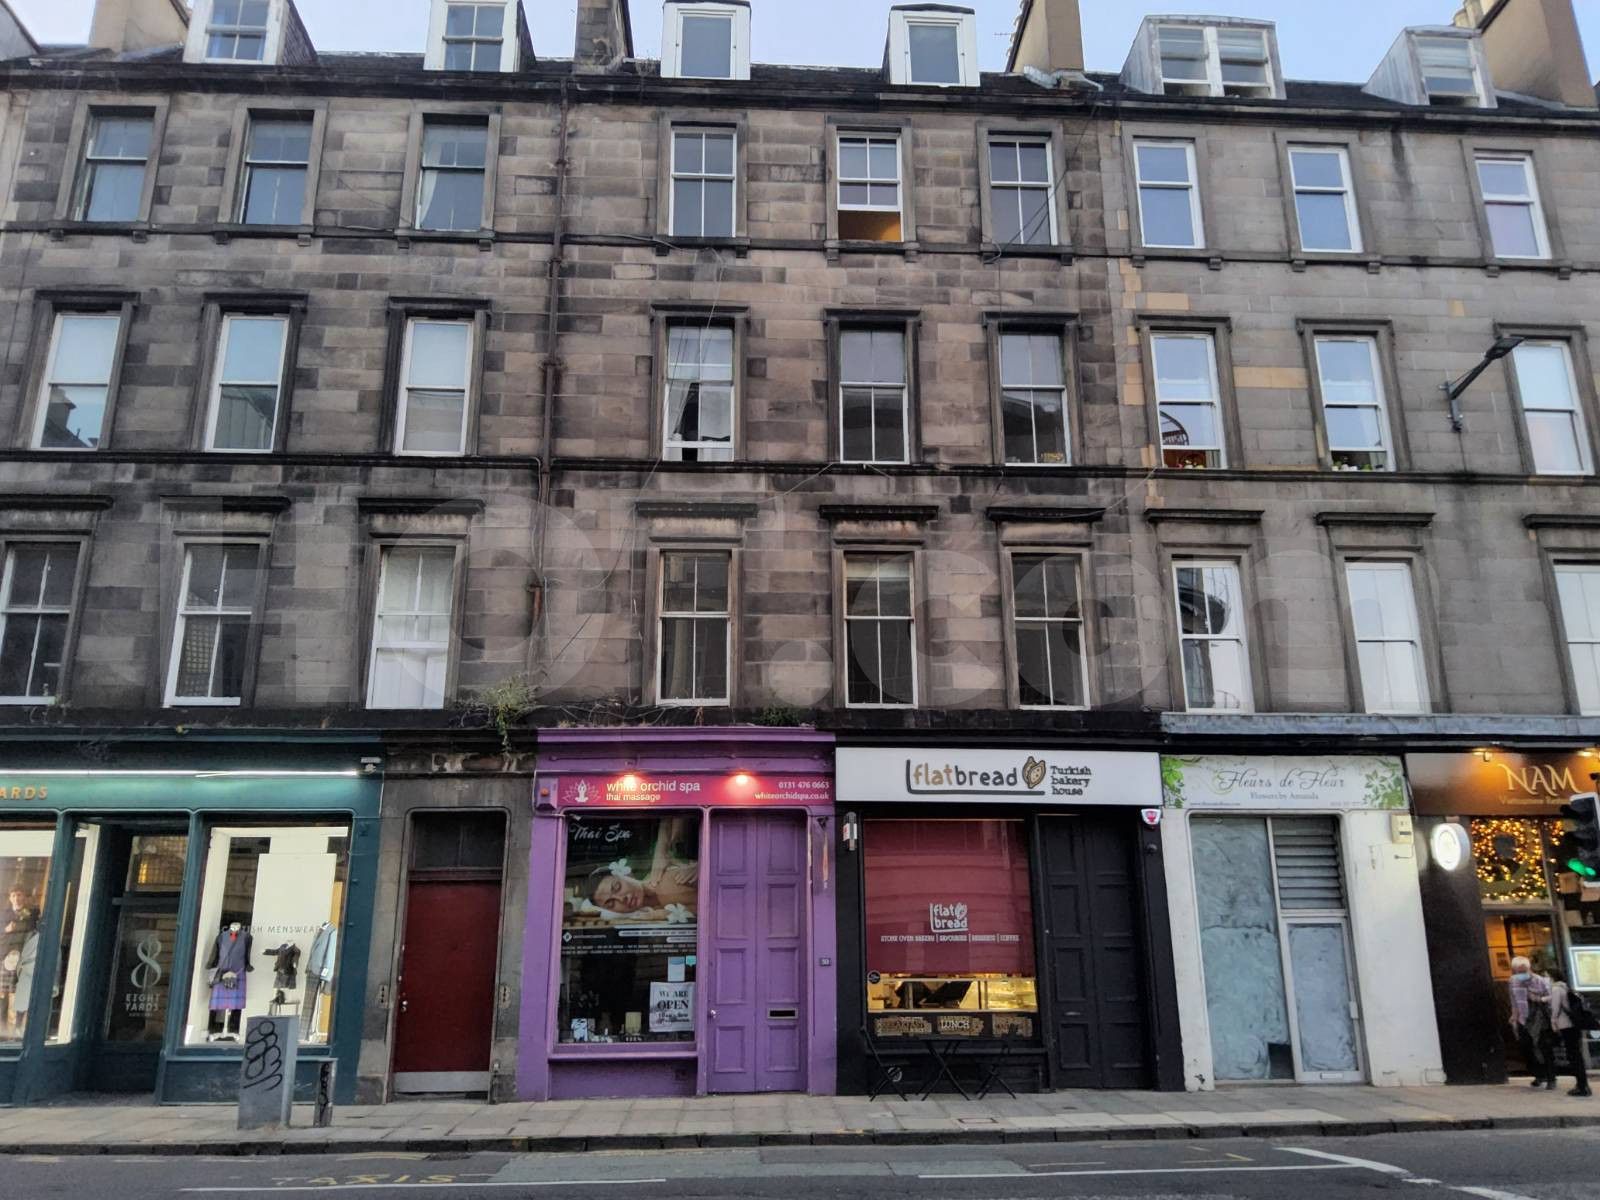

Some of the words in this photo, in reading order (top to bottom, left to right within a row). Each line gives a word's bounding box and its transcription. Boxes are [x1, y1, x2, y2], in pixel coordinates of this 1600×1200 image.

[912, 763, 1018, 787] flatbread
[1050, 765, 1092, 776] Turkish
[1050, 775, 1091, 788] bakery
[1218, 768, 1272, 791] Fleurs
[1279, 768, 1297, 788] de
[1298, 768, 1346, 791] Fleur
[1496, 763, 1584, 797] NAM
[640, 781, 676, 792] orchid
[679, 783, 701, 794] spa
[1051, 785, 1083, 796] house
[606, 793, 621, 801] thai
[623, 794, 661, 802] massage
[569, 823, 602, 841] Thai
[604, 823, 632, 842] Spa
[933, 904, 955, 917] flat
[934, 917, 968, 929] bread
[125, 993, 160, 1002] EIGHT
[125, 1002, 159, 1012] YARDS
[657, 999, 689, 1010] OPEN
